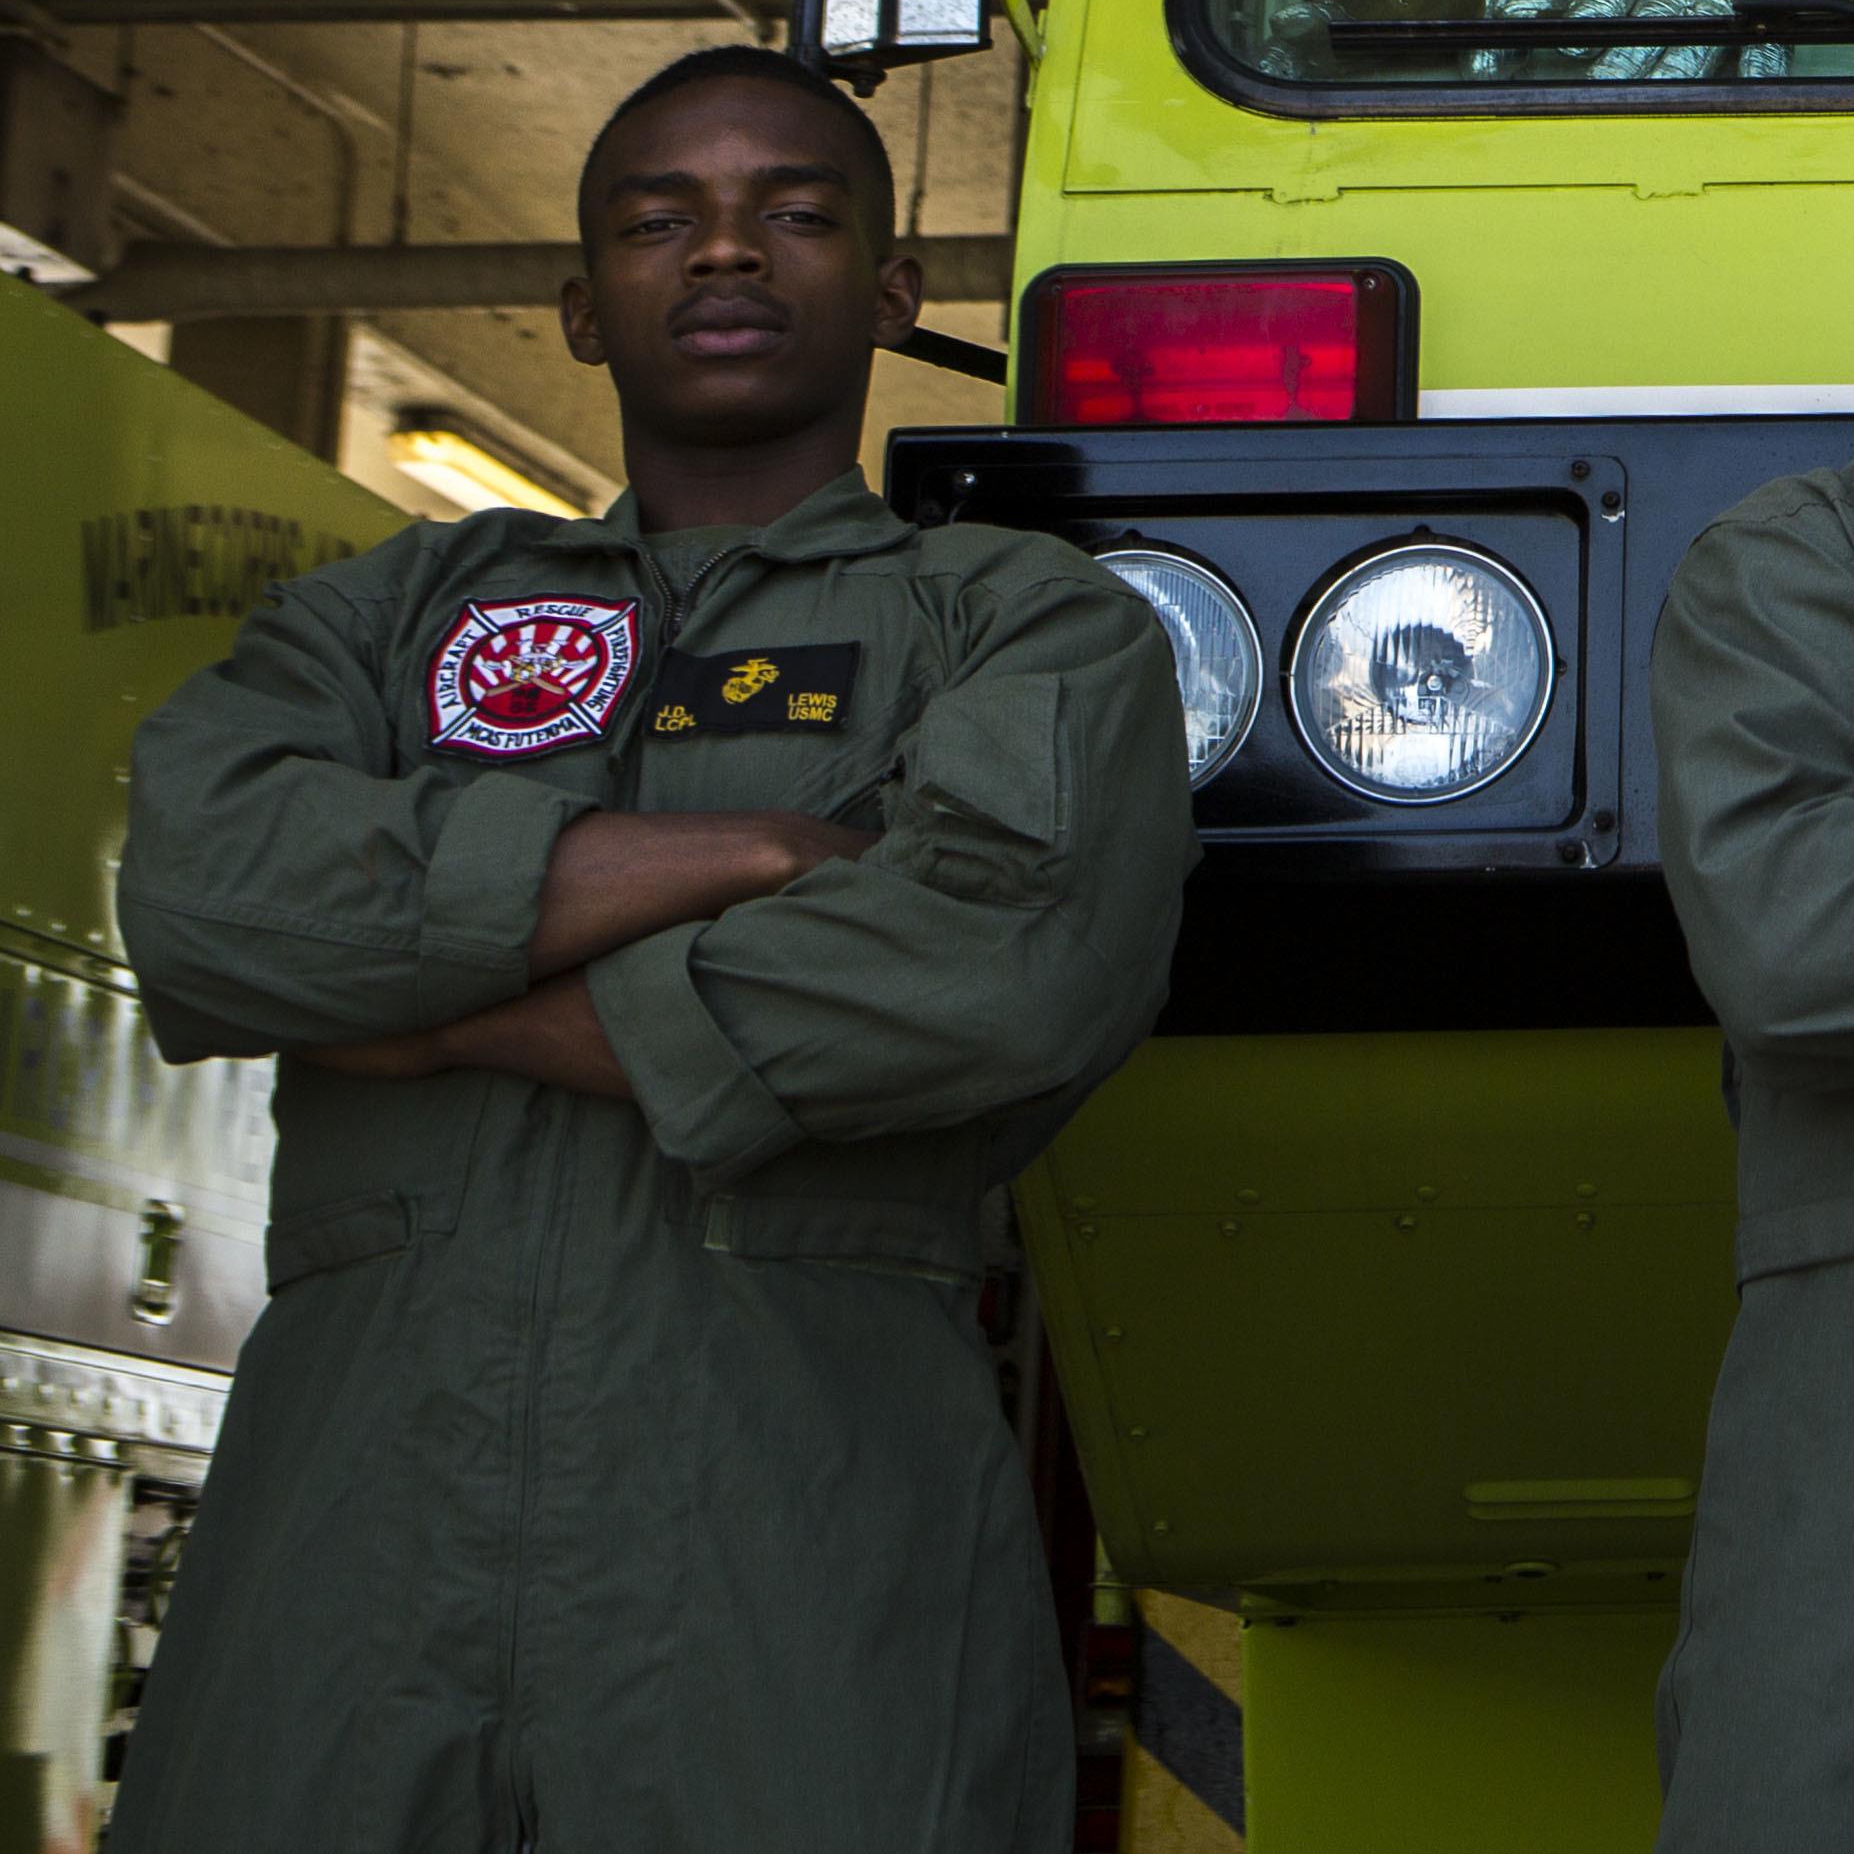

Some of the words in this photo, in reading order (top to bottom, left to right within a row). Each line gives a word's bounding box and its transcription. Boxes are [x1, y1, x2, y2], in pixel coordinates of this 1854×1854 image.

[515, 604, 595, 619] RESCUE
[440, 629, 479, 709] AIRCRAFT
[585, 625, 629, 712] FIREFIGHTING
[788, 693, 837, 708] LEWIS
[457, 722, 500, 748] MCAS
[505, 717, 580, 748] FUTENMA
[655, 714, 696, 731] LCPL
[788, 707, 833, 722] USMC
